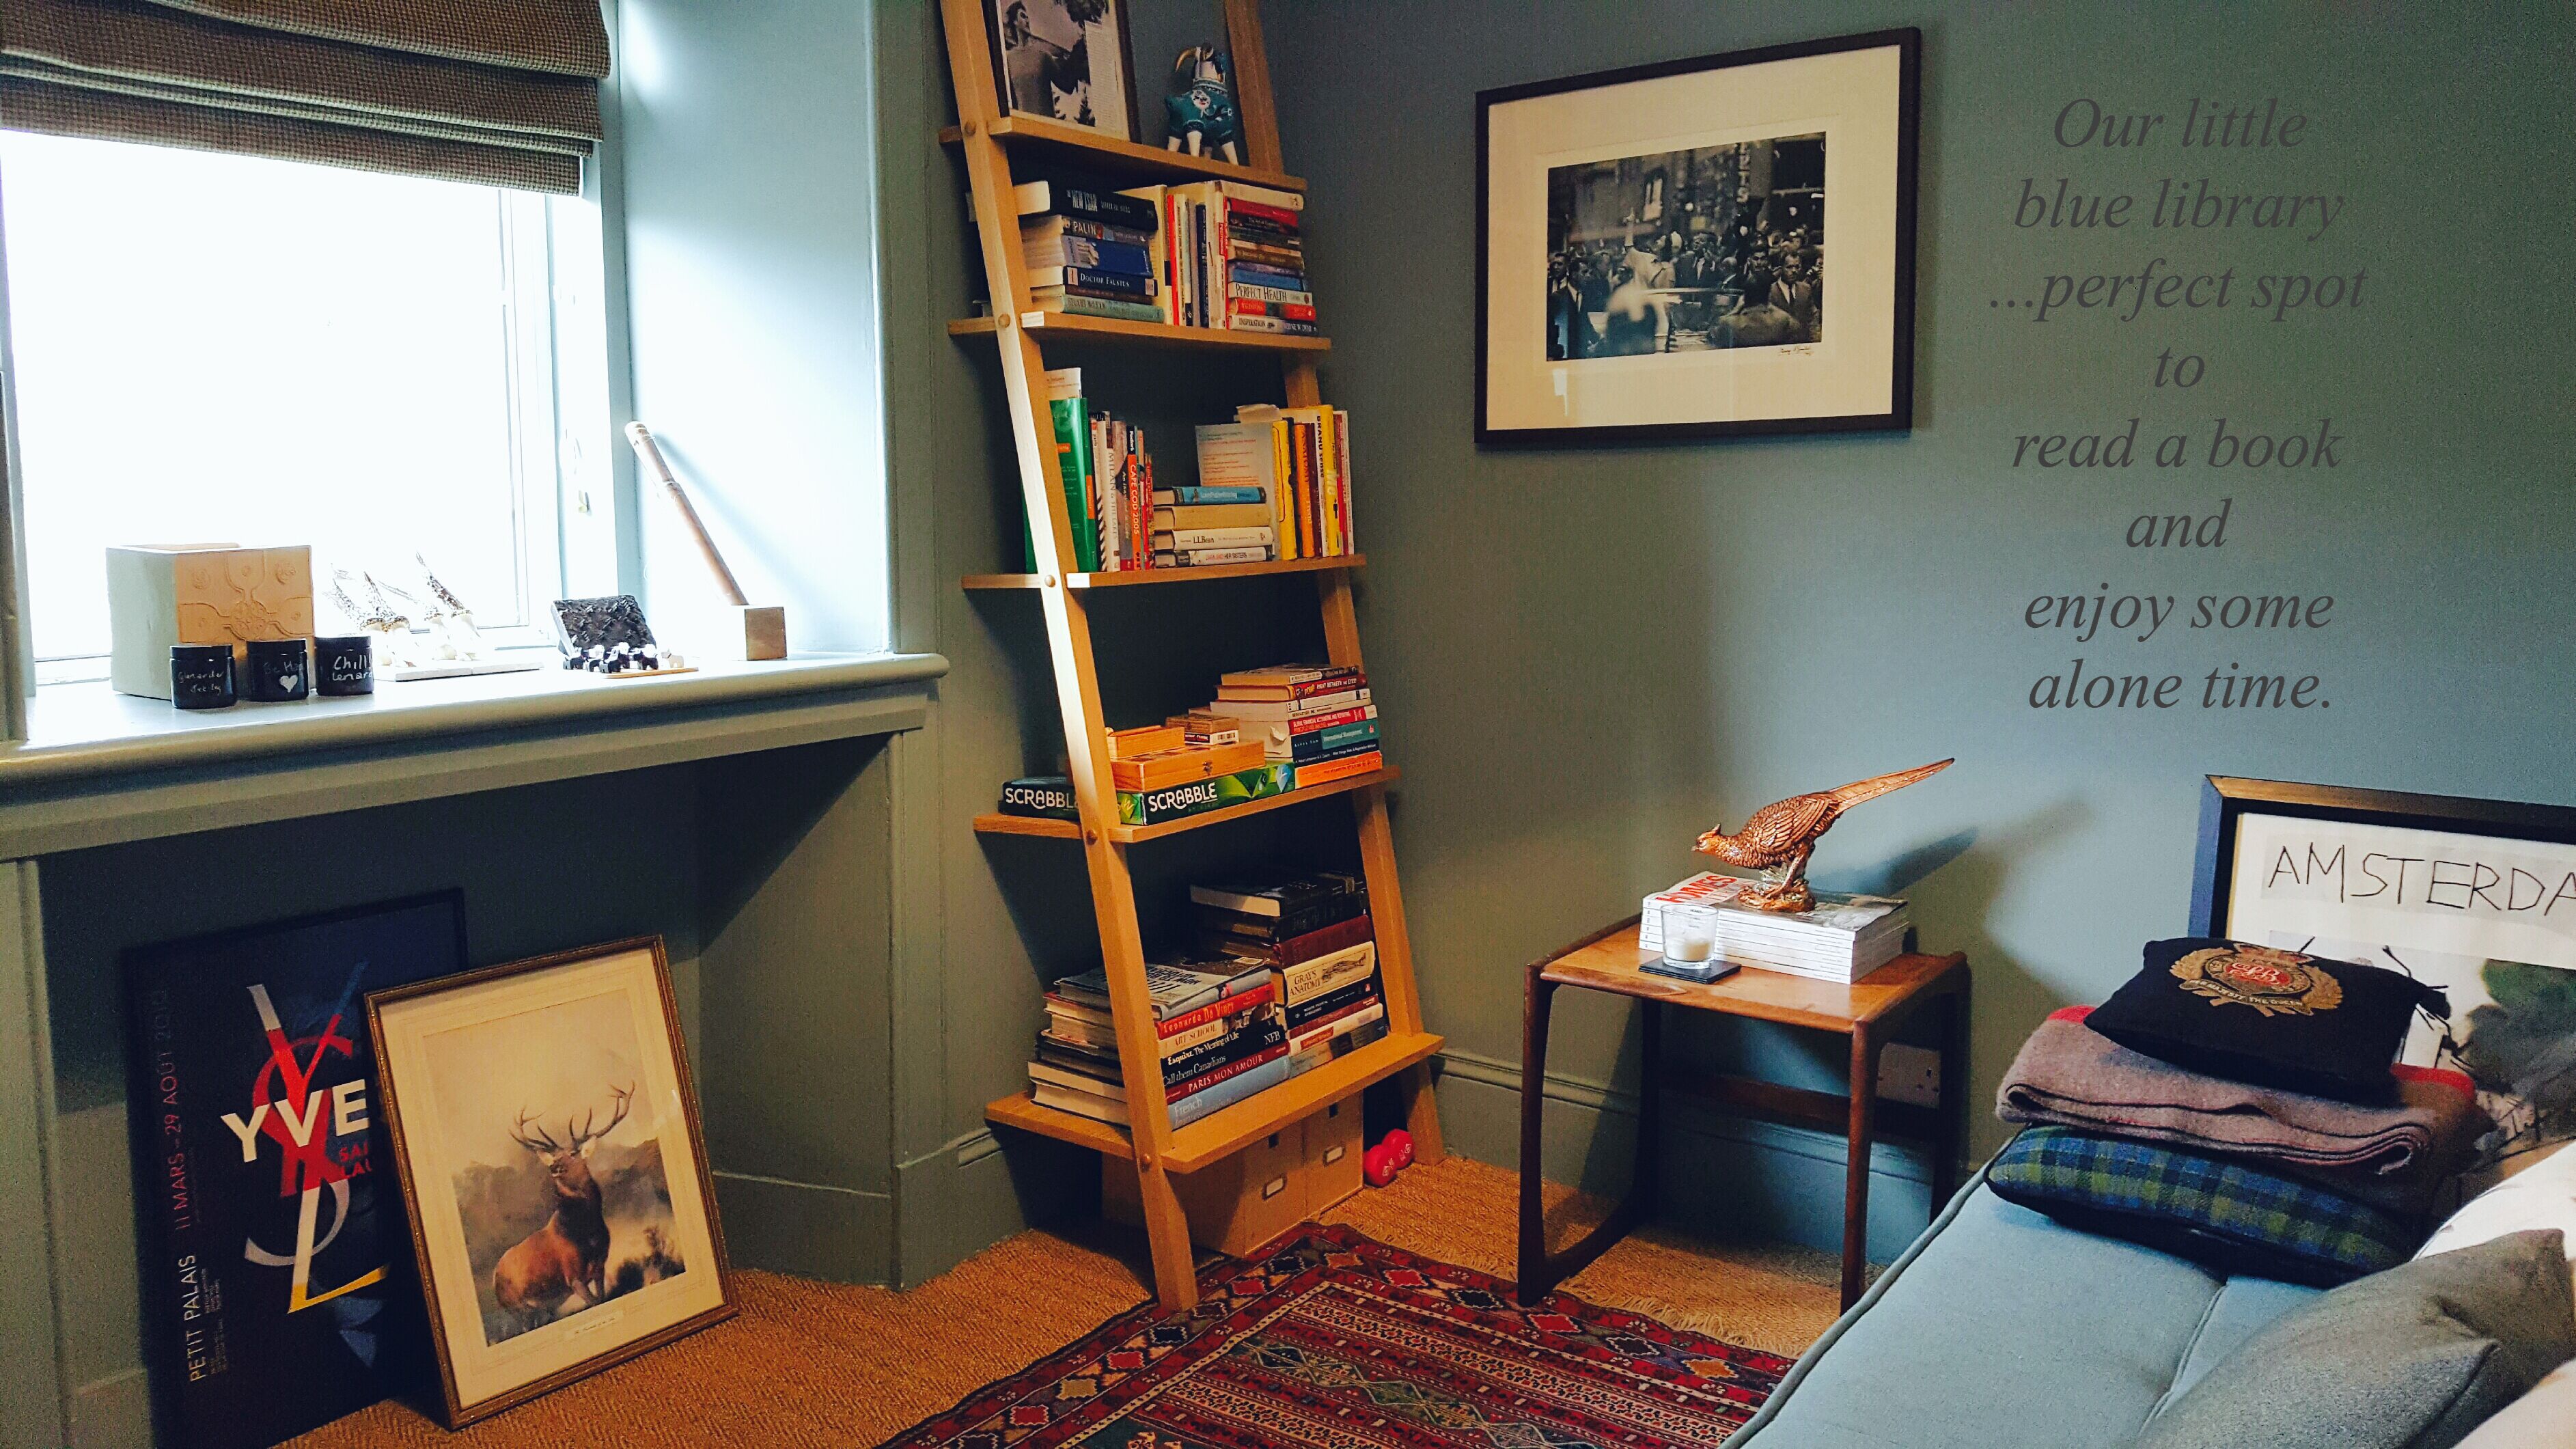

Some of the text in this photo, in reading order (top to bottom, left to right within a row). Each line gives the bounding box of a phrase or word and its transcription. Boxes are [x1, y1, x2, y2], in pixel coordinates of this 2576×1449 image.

[1073, 221, 1096, 235] PALIN
[1235, 283, 1288, 302] PERFECT HEALTH
[1107, 452, 1117, 491] MILAN
[1148, 782, 1218, 812] SCRABBLE
[1655, 875, 1738, 903] HOMES
[1288, 978, 1322, 997] ANATOMY
[1163, 1012, 1202, 1034] Leonardo
[1189, 1024, 1217, 1040] SCHOOL
[1193, 1047, 1204, 1055] The
[1203, 1038, 1226, 1053] Meaning
[1229, 1032, 1240, 1041] Life
[1264, 1030, 1281, 1045] NFB
[1163, 1055, 1227, 1087] Call them Canadians
[1188, 1054, 1263, 1093] PARIS MON AMOUR
[1174, 1096, 1203, 1117] French
[164, 1114, 182, 1135] 29
[220, 1078, 370, 1163] YVE
[167, 1152, 189, 1211] MARS
[178, 1254, 206, 1382] PETIT PALAIS
